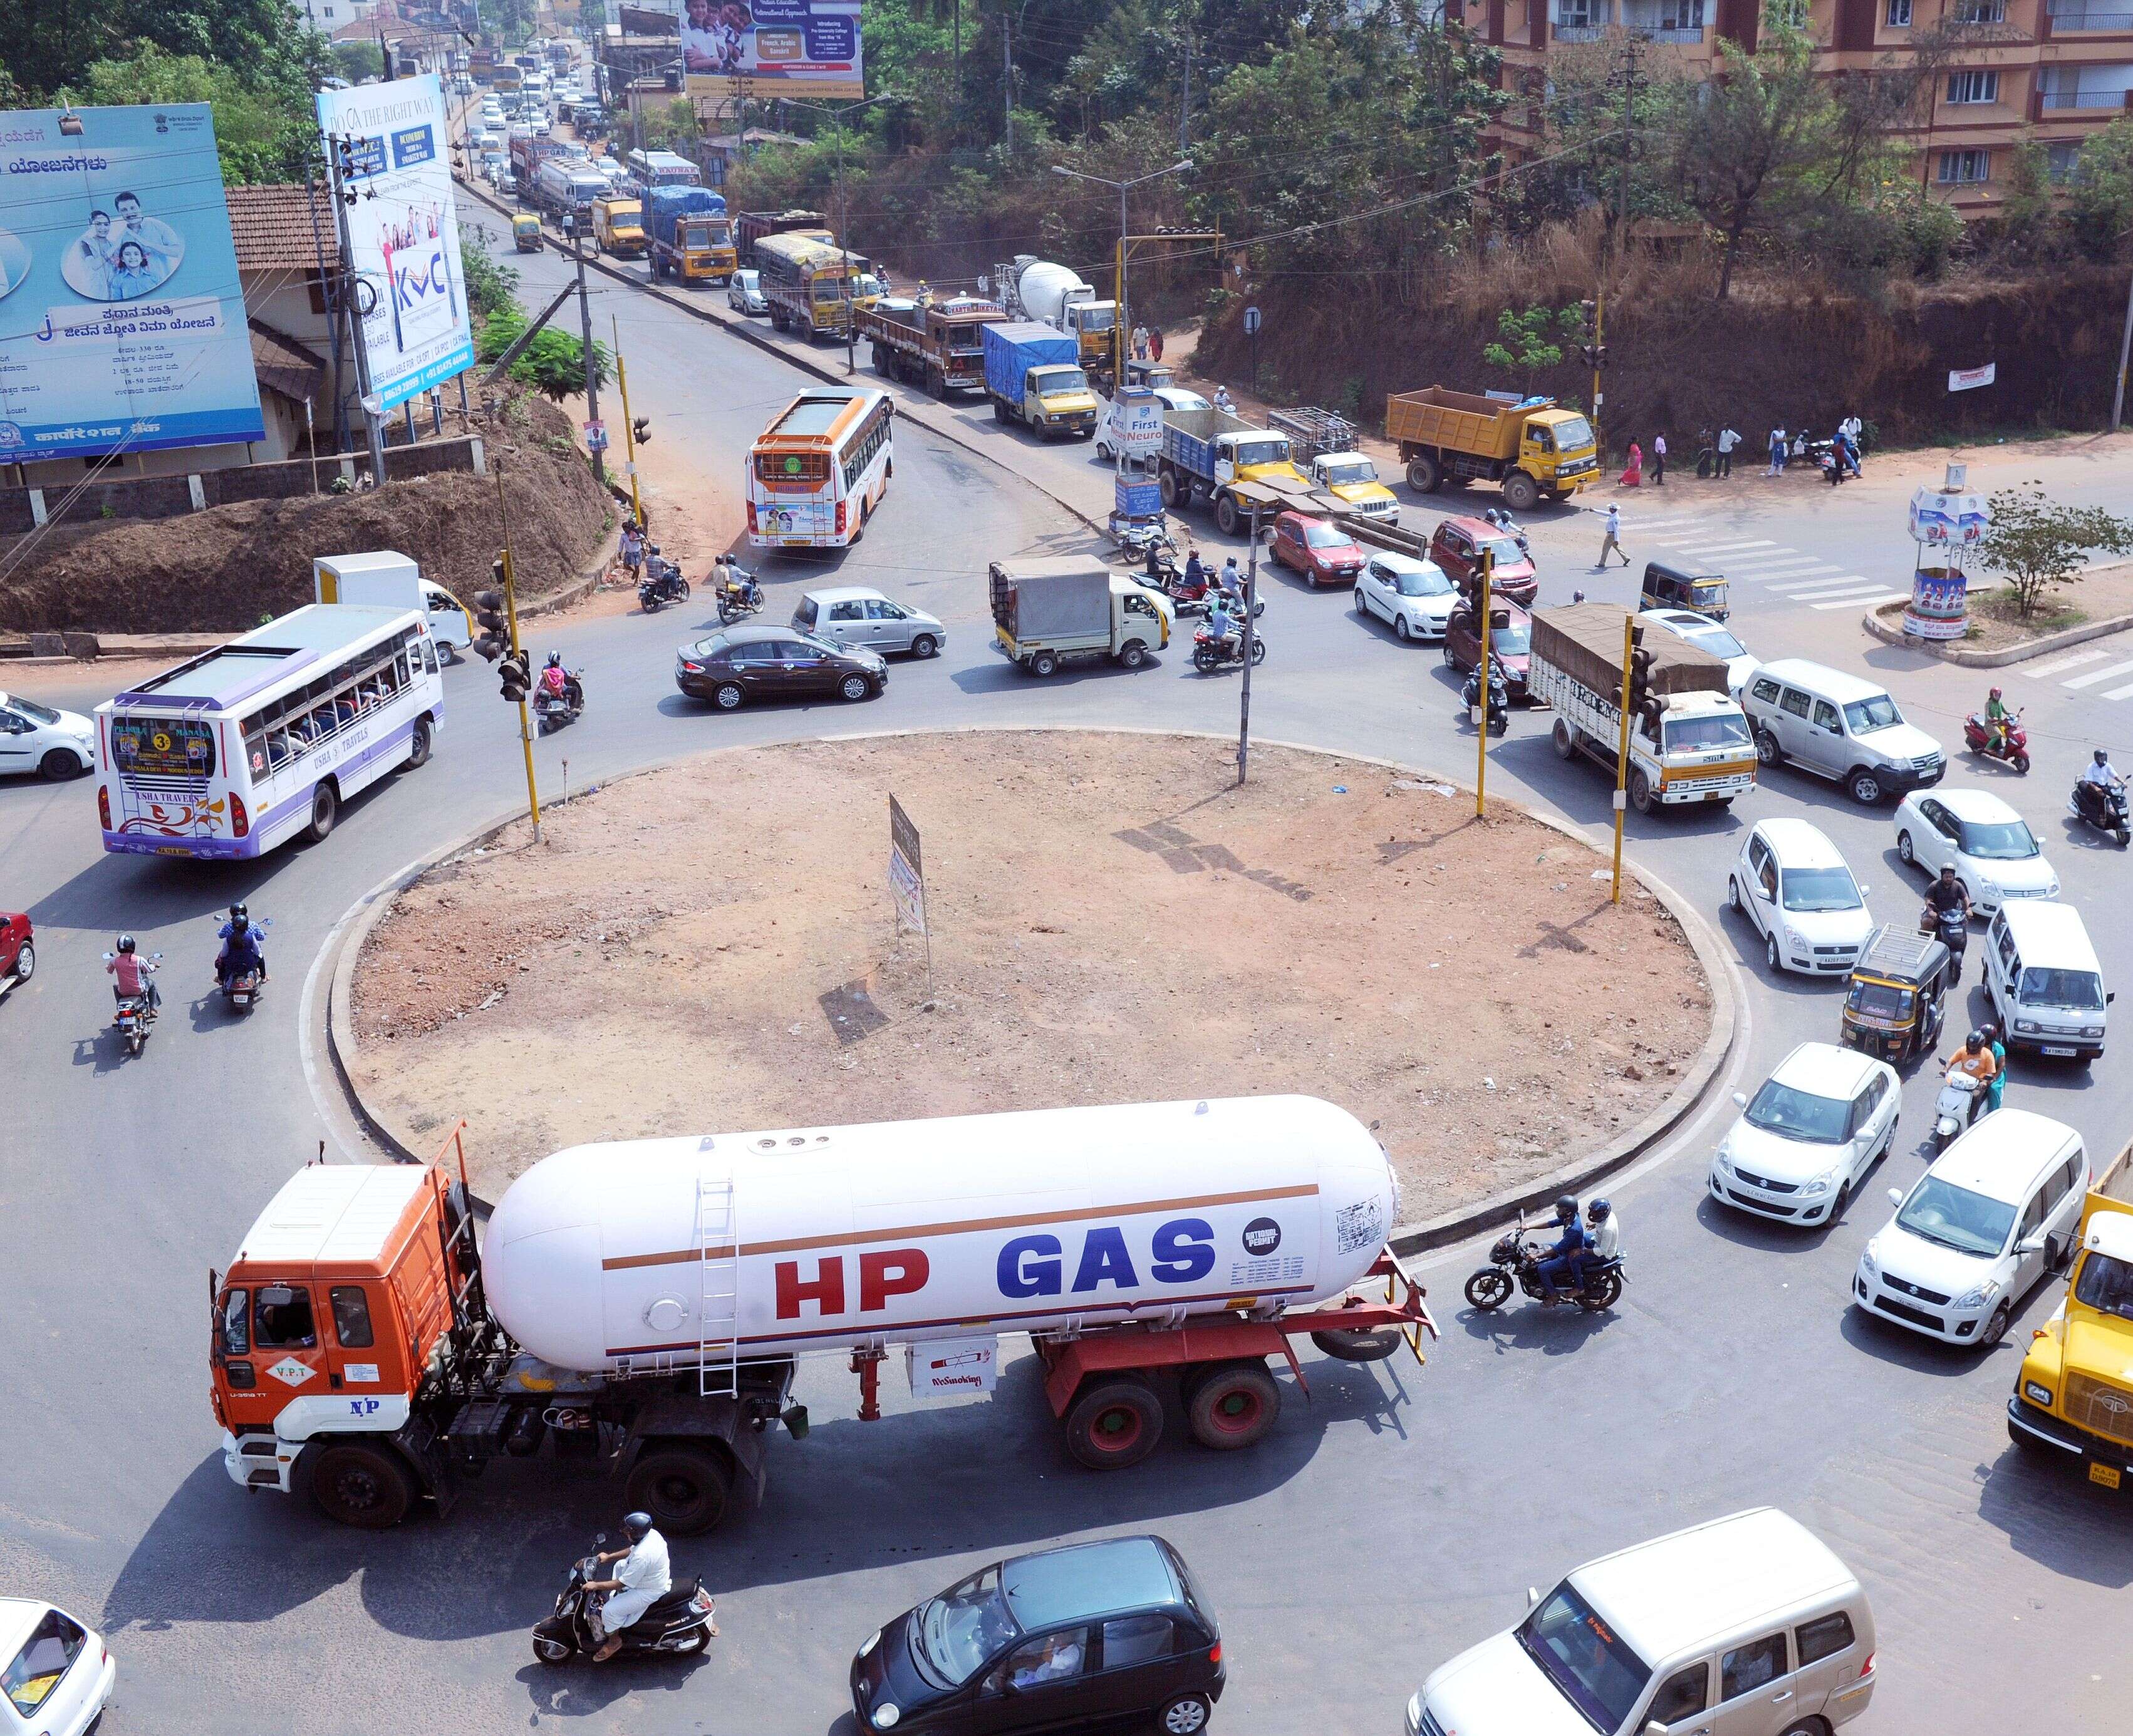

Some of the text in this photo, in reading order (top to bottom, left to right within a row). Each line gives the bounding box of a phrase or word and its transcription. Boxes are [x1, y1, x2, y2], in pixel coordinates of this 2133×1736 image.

[363, 106, 382, 127] THE
[384, 100, 412, 123] RIGHT
[413, 95, 435, 117] WAY
[9, 155, 107, 173] ಯೋಜನೆಗಳು
[64, 326, 100, 338] ಜೀವನ
[169, 316, 215, 329] ಯೋಜನೆ
[365, 331, 390, 352] VAILABLE
[1113, 415, 1124, 430] First
[1133, 420, 1158, 430] First
[1128, 430, 1163, 442] Neuro
[157, 735, 165, 748] 3
[314, 750, 331, 769] USHA
[341, 727, 368, 752] TRAVELS
[137, 792, 199, 803] USHA TRAVELS
[1245, 1227, 1278, 1241] NATIONAL
[1248, 1236, 1275, 1248] PERMIT
[775, 1248, 930, 1320] HP
[997, 1218, 1215, 1298] GAS
